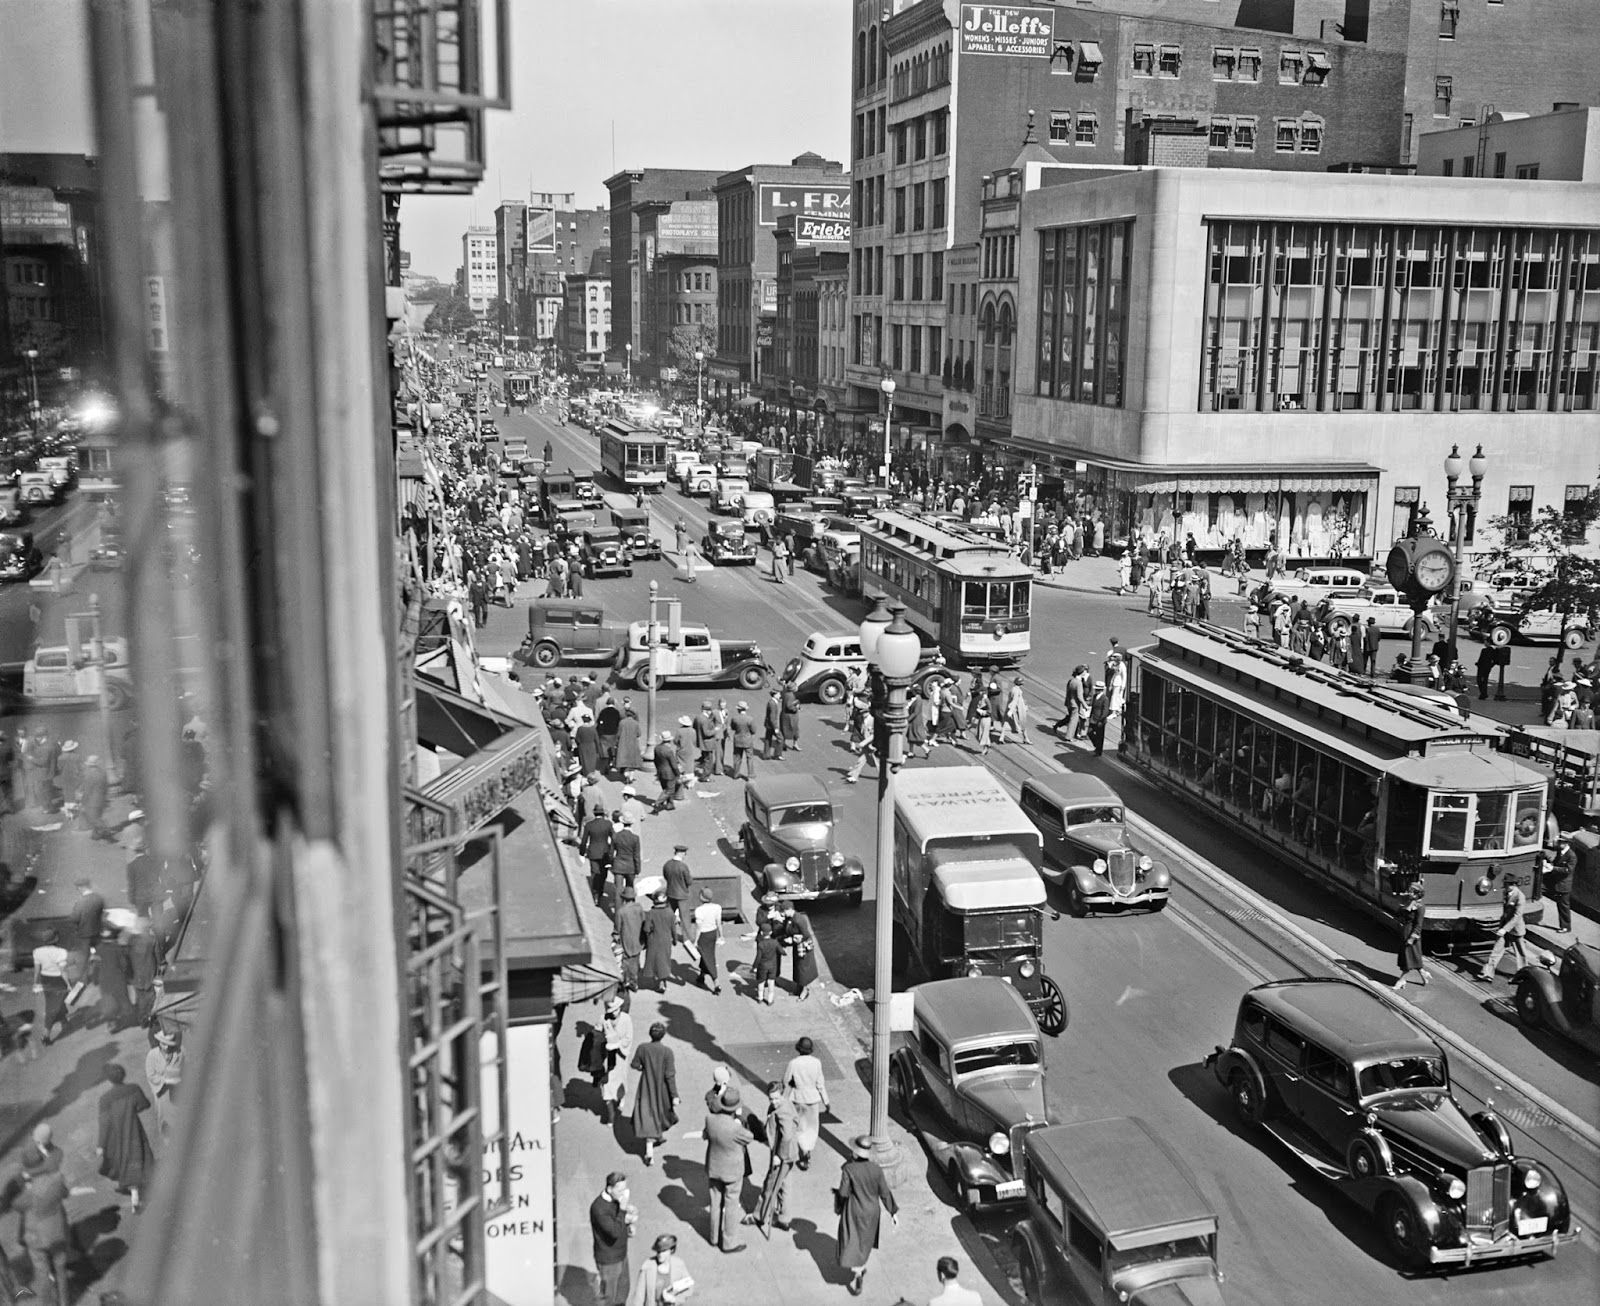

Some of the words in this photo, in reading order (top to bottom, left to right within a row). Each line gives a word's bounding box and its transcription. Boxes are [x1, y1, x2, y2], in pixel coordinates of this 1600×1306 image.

[965, 7, 1051, 35] Jelleff's
[964, 34, 990, 43] WOMEN'S
[967, 43, 995, 52] APPAREL
[1005, 45, 1046, 54] ACCESSORIES
[661, 228, 699, 236] PHOTOPLAYS
[907, 789, 1000, 799] EXPRESS
[915, 797, 1006, 806] RAILWAY
[487, 1220, 544, 1238] OMEN
